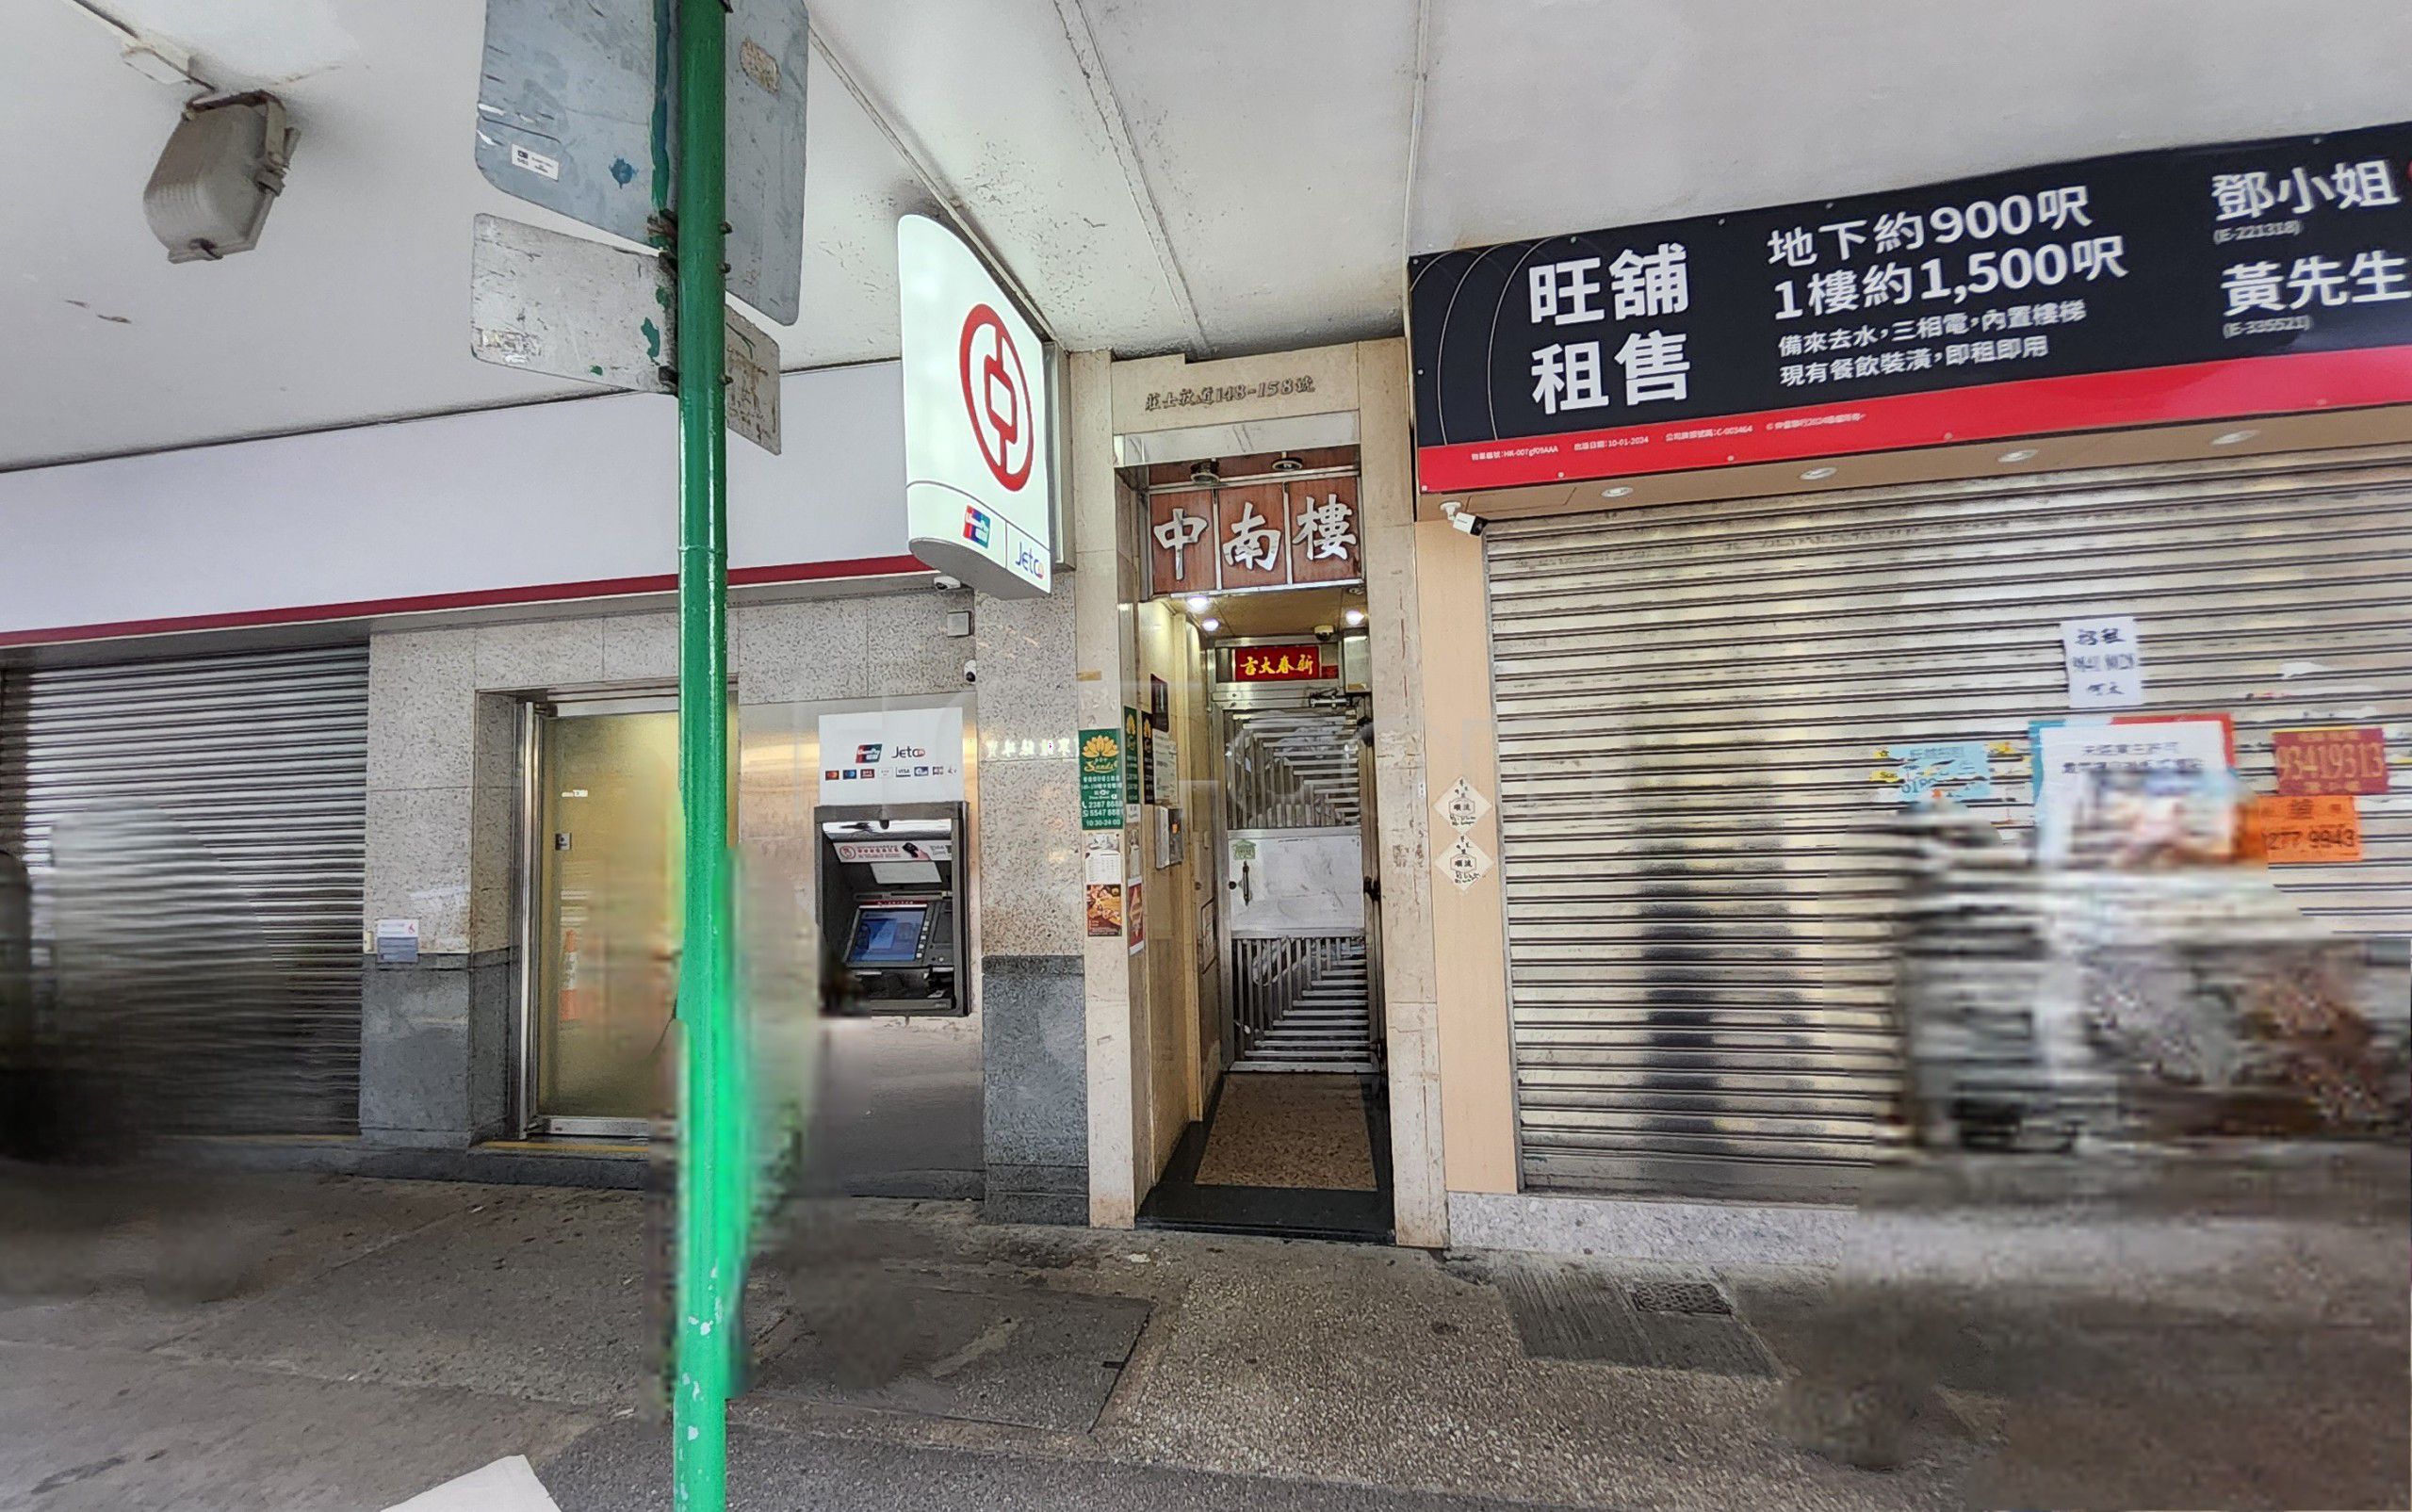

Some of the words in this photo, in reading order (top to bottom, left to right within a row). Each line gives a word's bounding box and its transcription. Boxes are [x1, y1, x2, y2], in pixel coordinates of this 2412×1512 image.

[1767, 185, 2094, 268] 地下約900呎
[2211, 159, 2402, 221] 鄧小姐
[1527, 241, 1689, 327] 旺舖
[1774, 235, 2129, 321] 1樓約1,500呎
[2220, 250, 2412, 317] 黃先生
[1530, 330, 1691, 415] 租售
[1153, 493, 1358, 581] 中南樓
